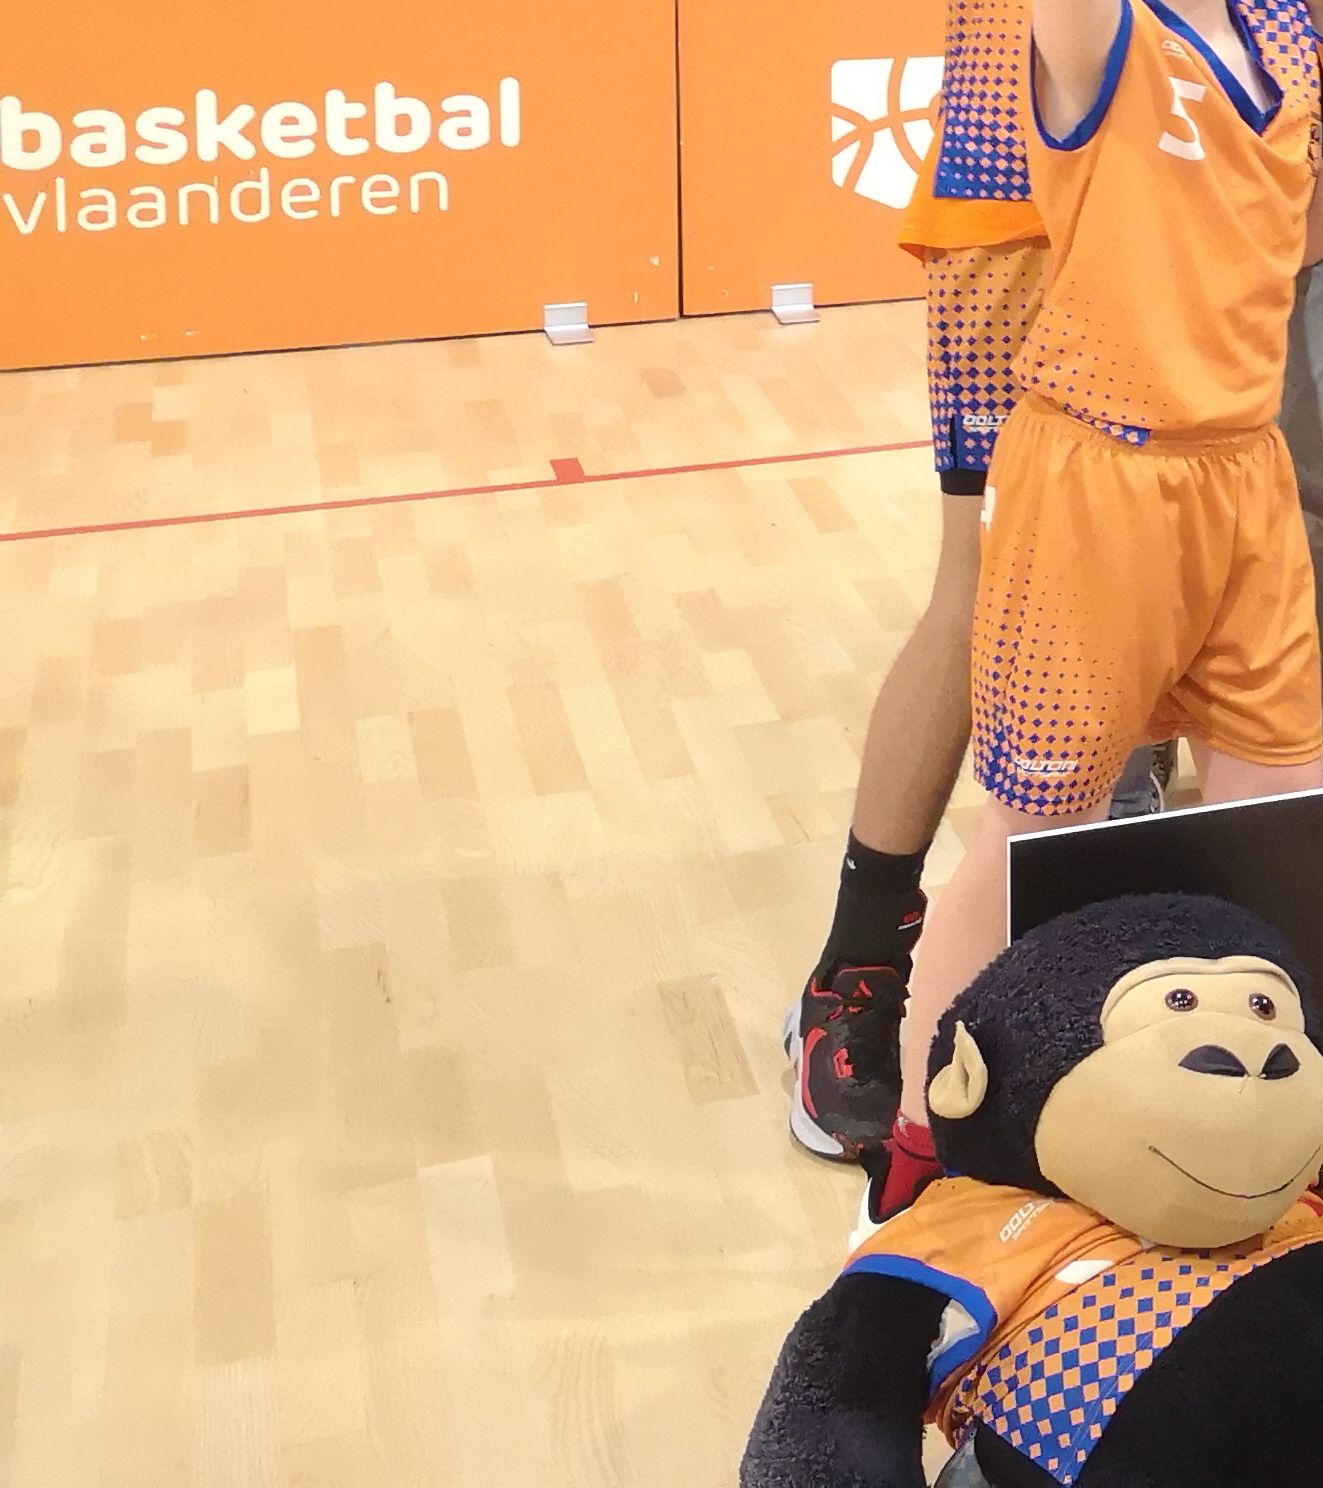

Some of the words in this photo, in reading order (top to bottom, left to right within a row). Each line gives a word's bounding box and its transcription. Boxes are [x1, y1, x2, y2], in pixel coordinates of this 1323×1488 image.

[0, 76, 521, 171] basketbal
[1158, 76, 1207, 161] 5
[3, 167, 449, 234] vlaanderen
